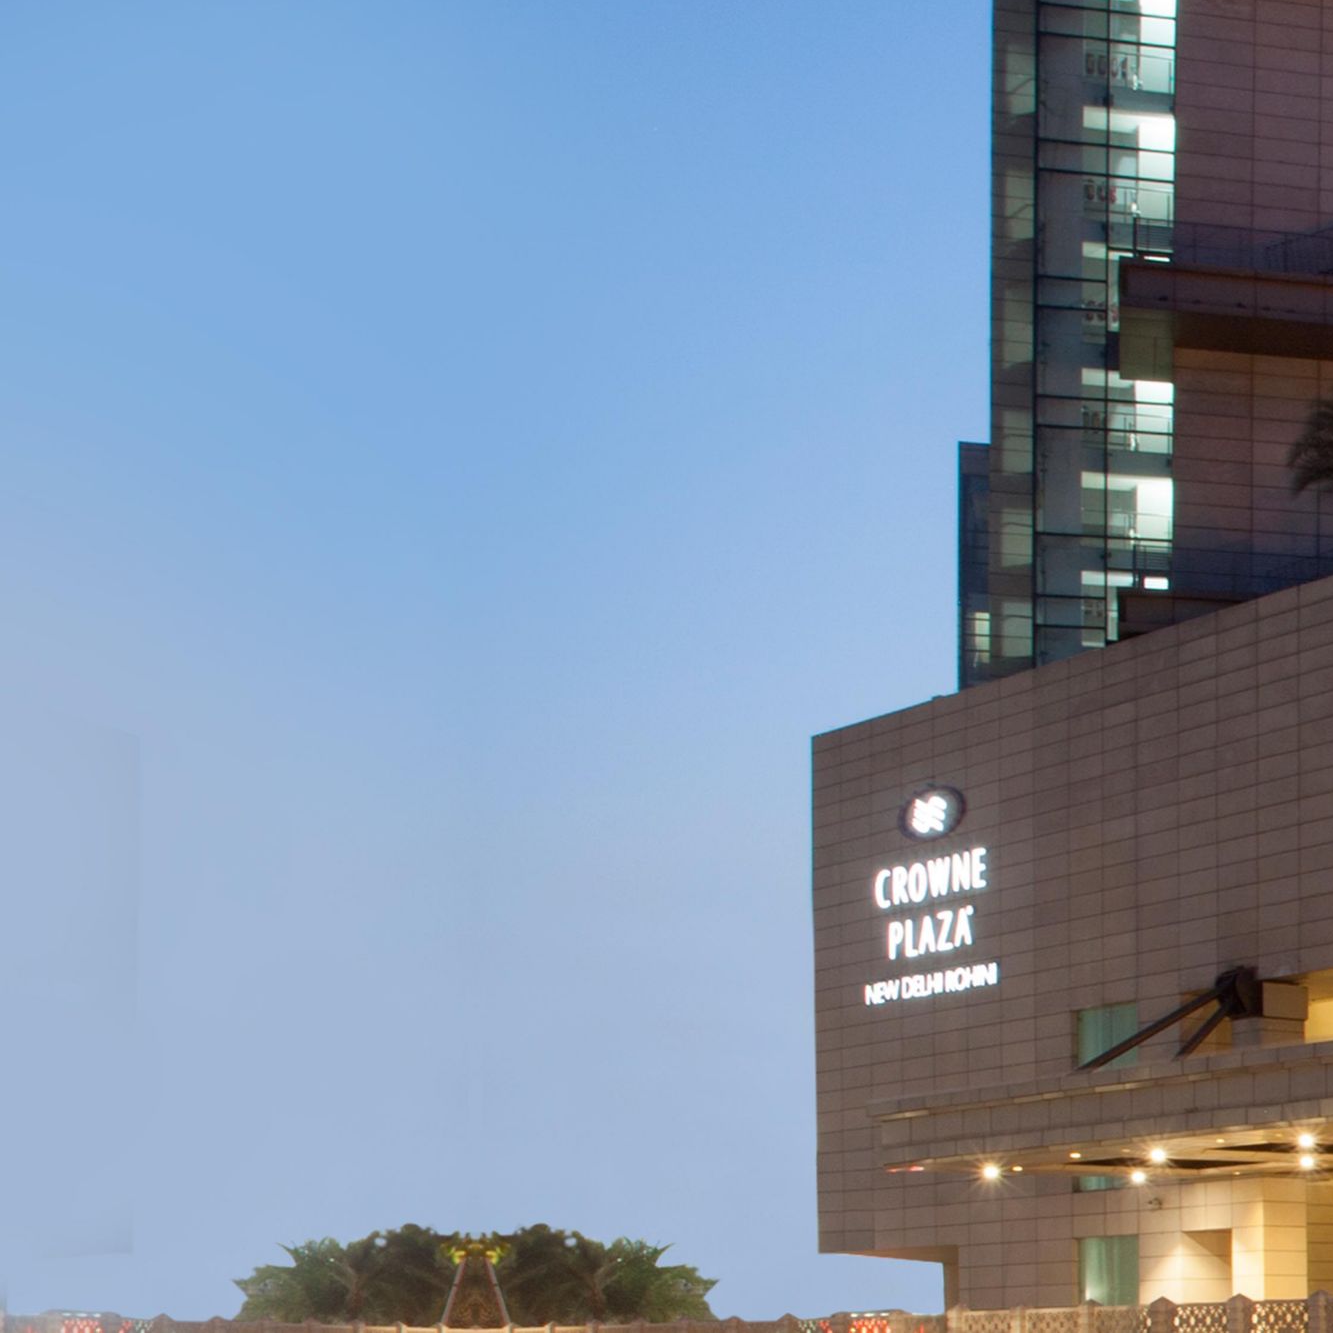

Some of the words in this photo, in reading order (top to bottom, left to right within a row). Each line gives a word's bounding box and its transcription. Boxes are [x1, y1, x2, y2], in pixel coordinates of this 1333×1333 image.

[874, 847, 988, 909] CROWNE
[886, 906, 974, 961] PLAZA
[864, 979, 900, 1006] NEW
[901, 971, 944, 1000] DELHI
[944, 962, 998, 993] ROHINI
